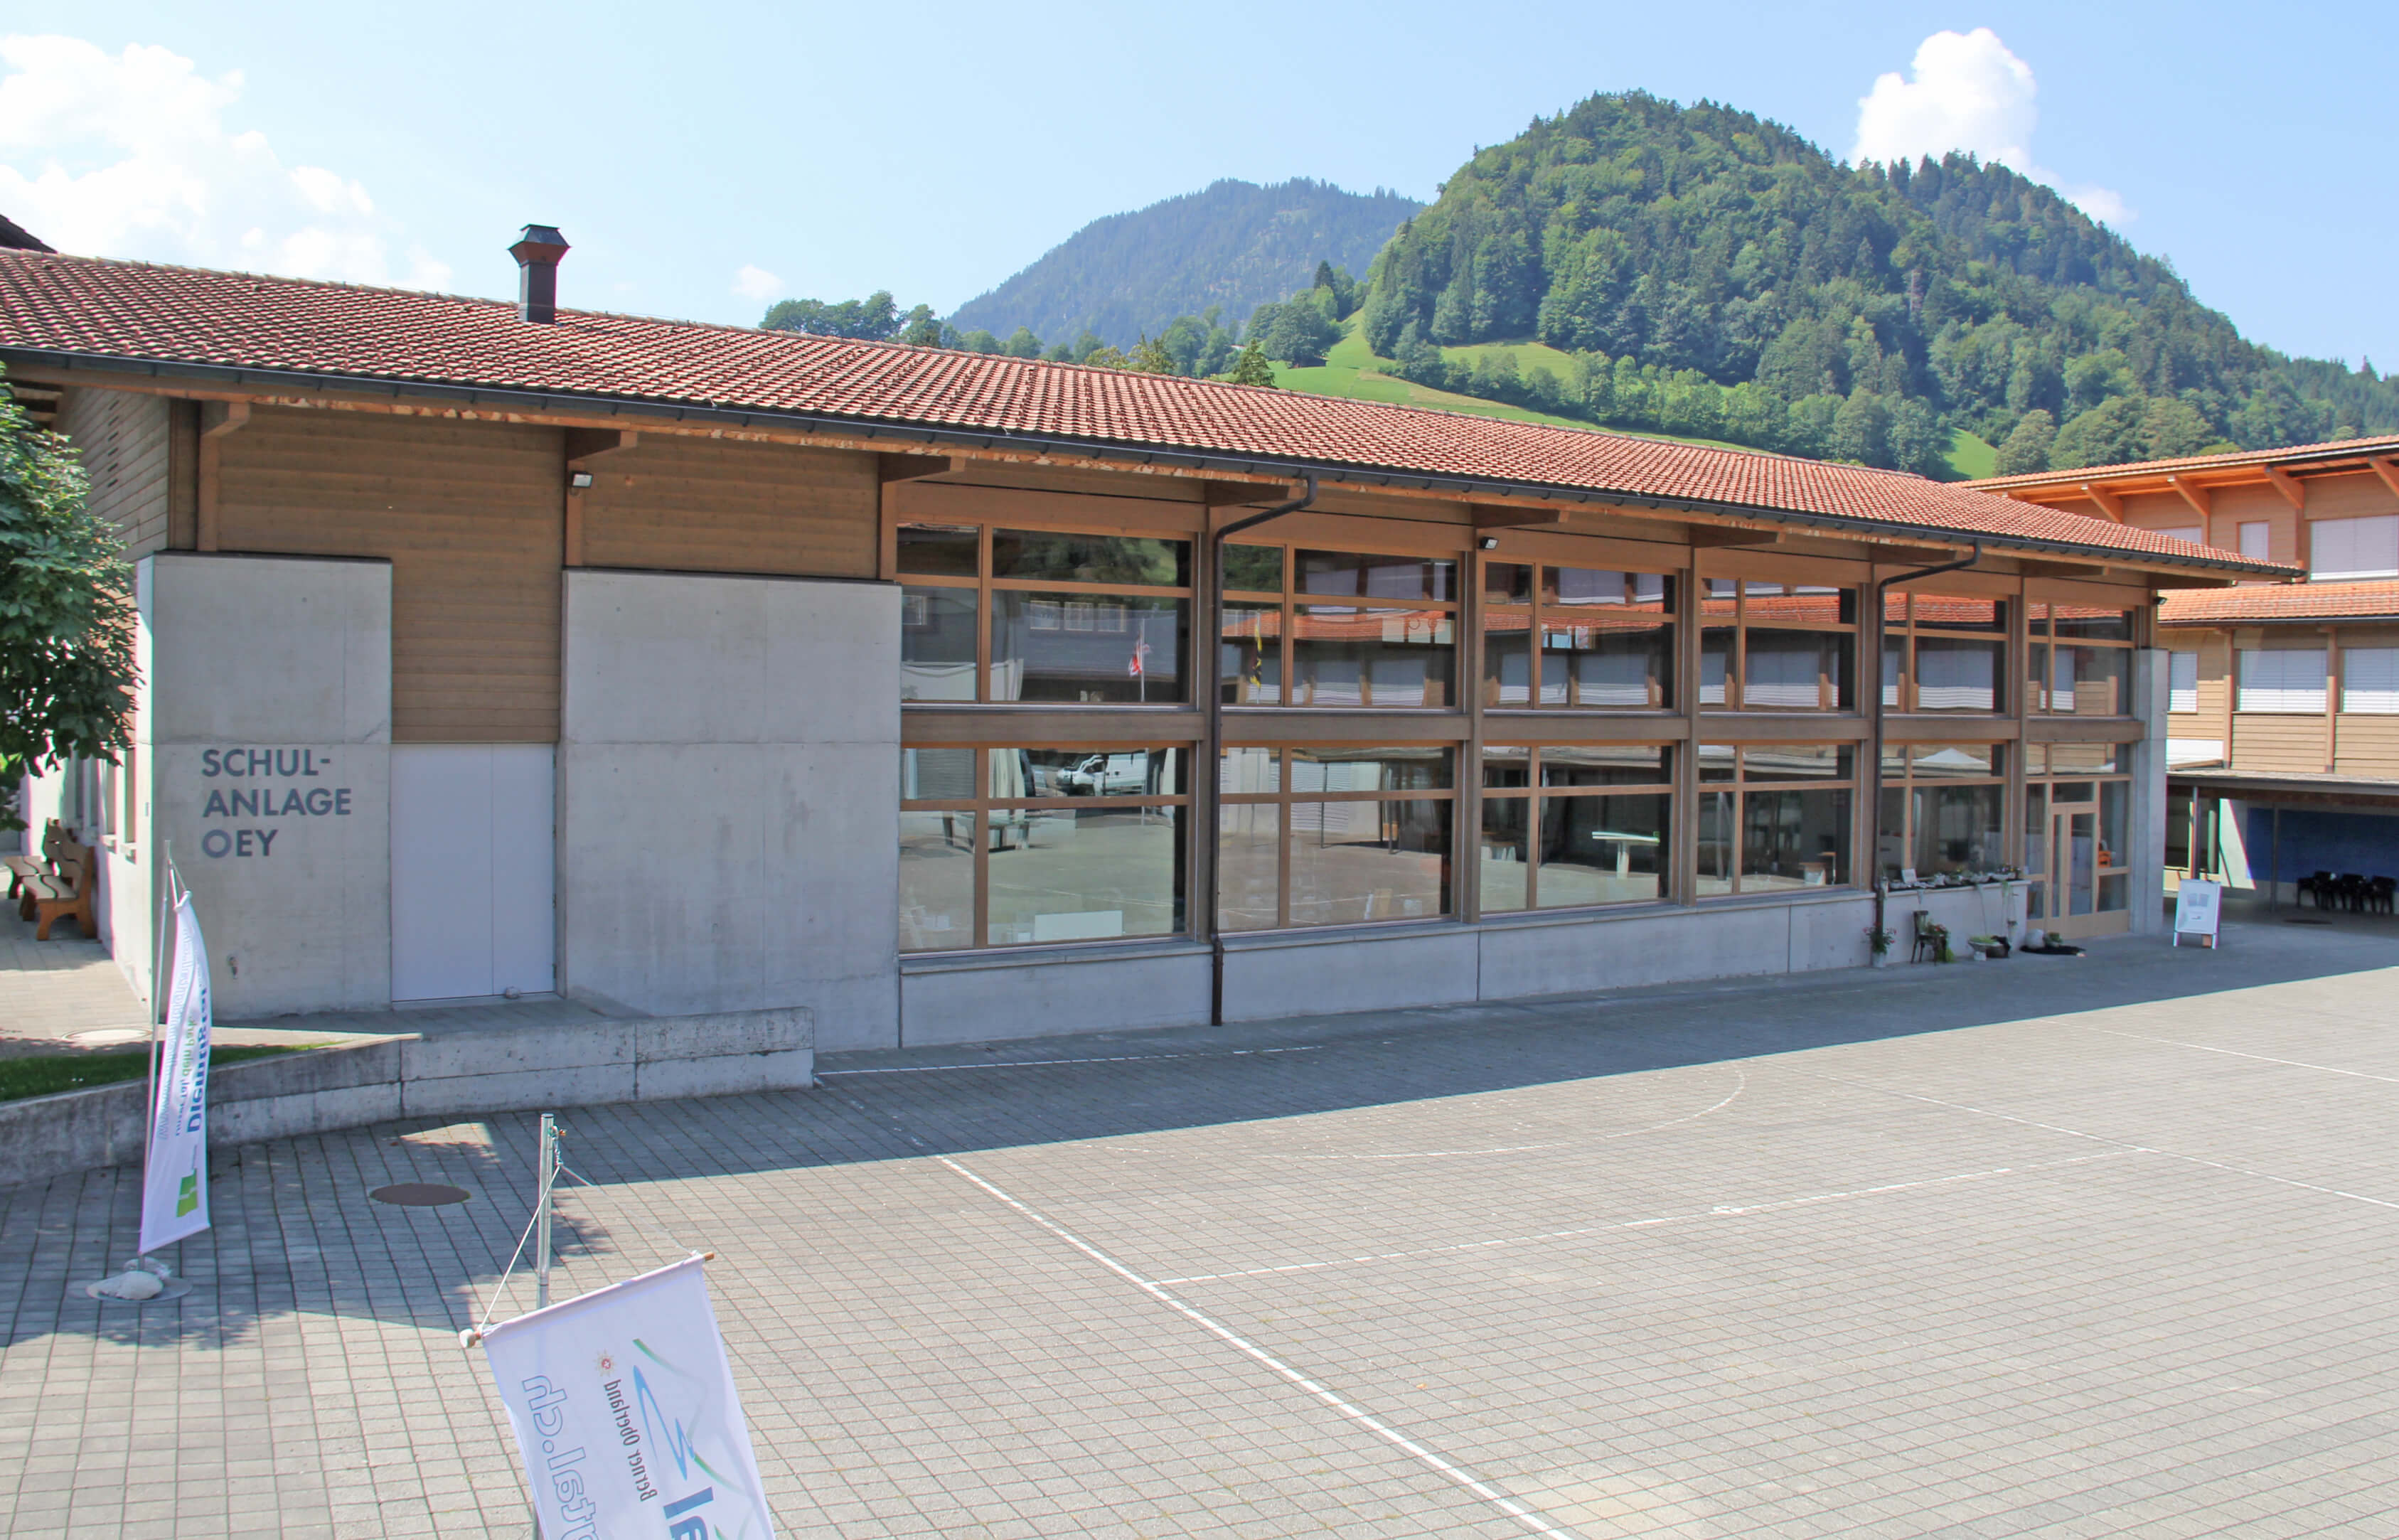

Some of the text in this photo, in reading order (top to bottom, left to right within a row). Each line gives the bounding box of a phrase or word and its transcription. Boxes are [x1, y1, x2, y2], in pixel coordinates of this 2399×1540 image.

[201, 749, 331, 777] SCHUL-
[202, 788, 351, 817] ANLAGE
[201, 829, 278, 858] OEY
